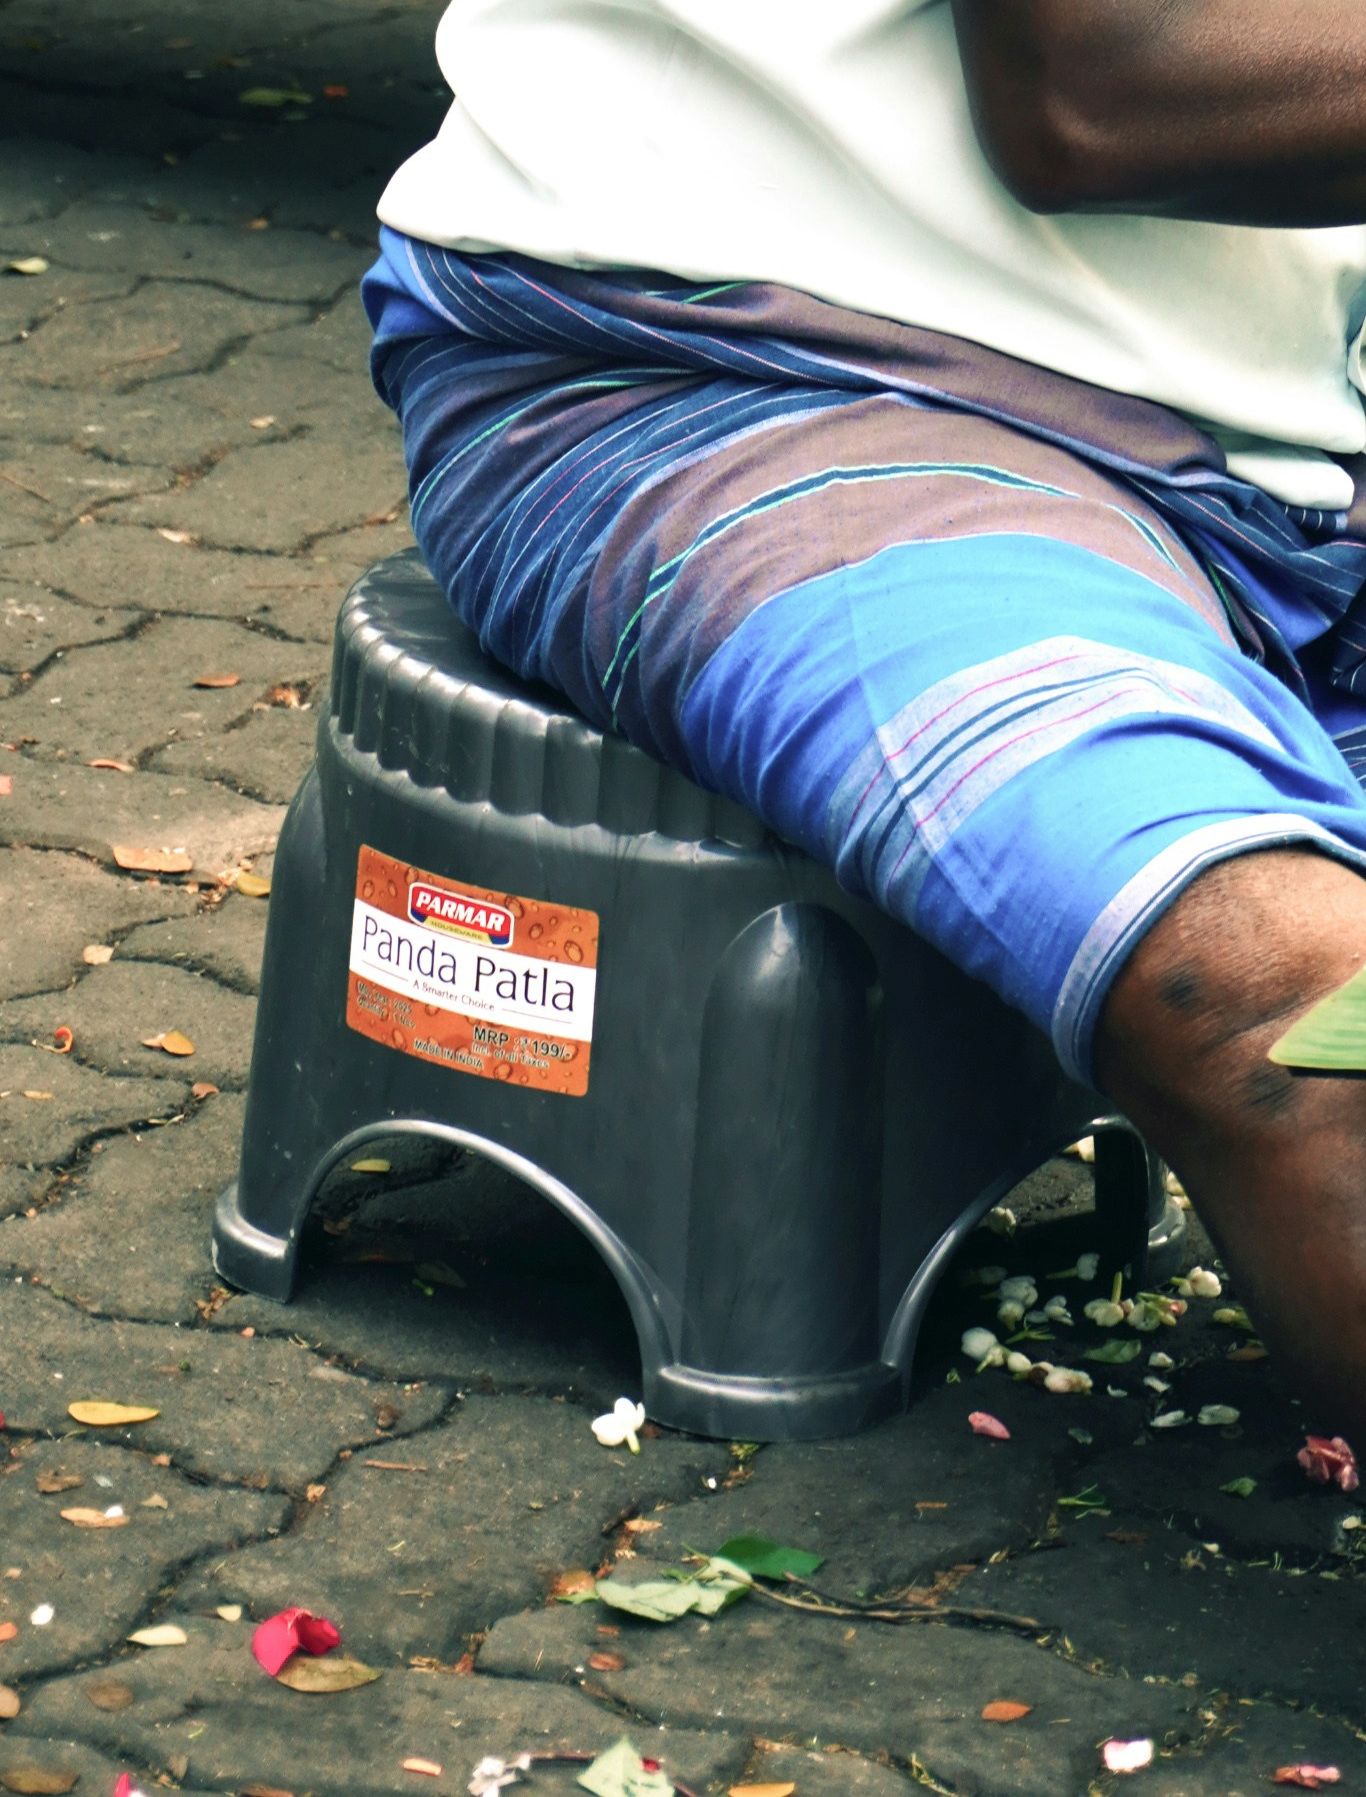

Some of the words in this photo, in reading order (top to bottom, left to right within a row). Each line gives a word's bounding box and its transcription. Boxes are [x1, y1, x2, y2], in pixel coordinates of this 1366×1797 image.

[416, 891, 505, 932] PARMAR
[362, 914, 457, 986] Panda
[474, 955, 575, 1012] Patla
[413, 979, 420, 989] A
[422, 982, 458, 1002] Smarter
[461, 994, 495, 1011] Choice
[474, 1026, 509, 1046] MRP
